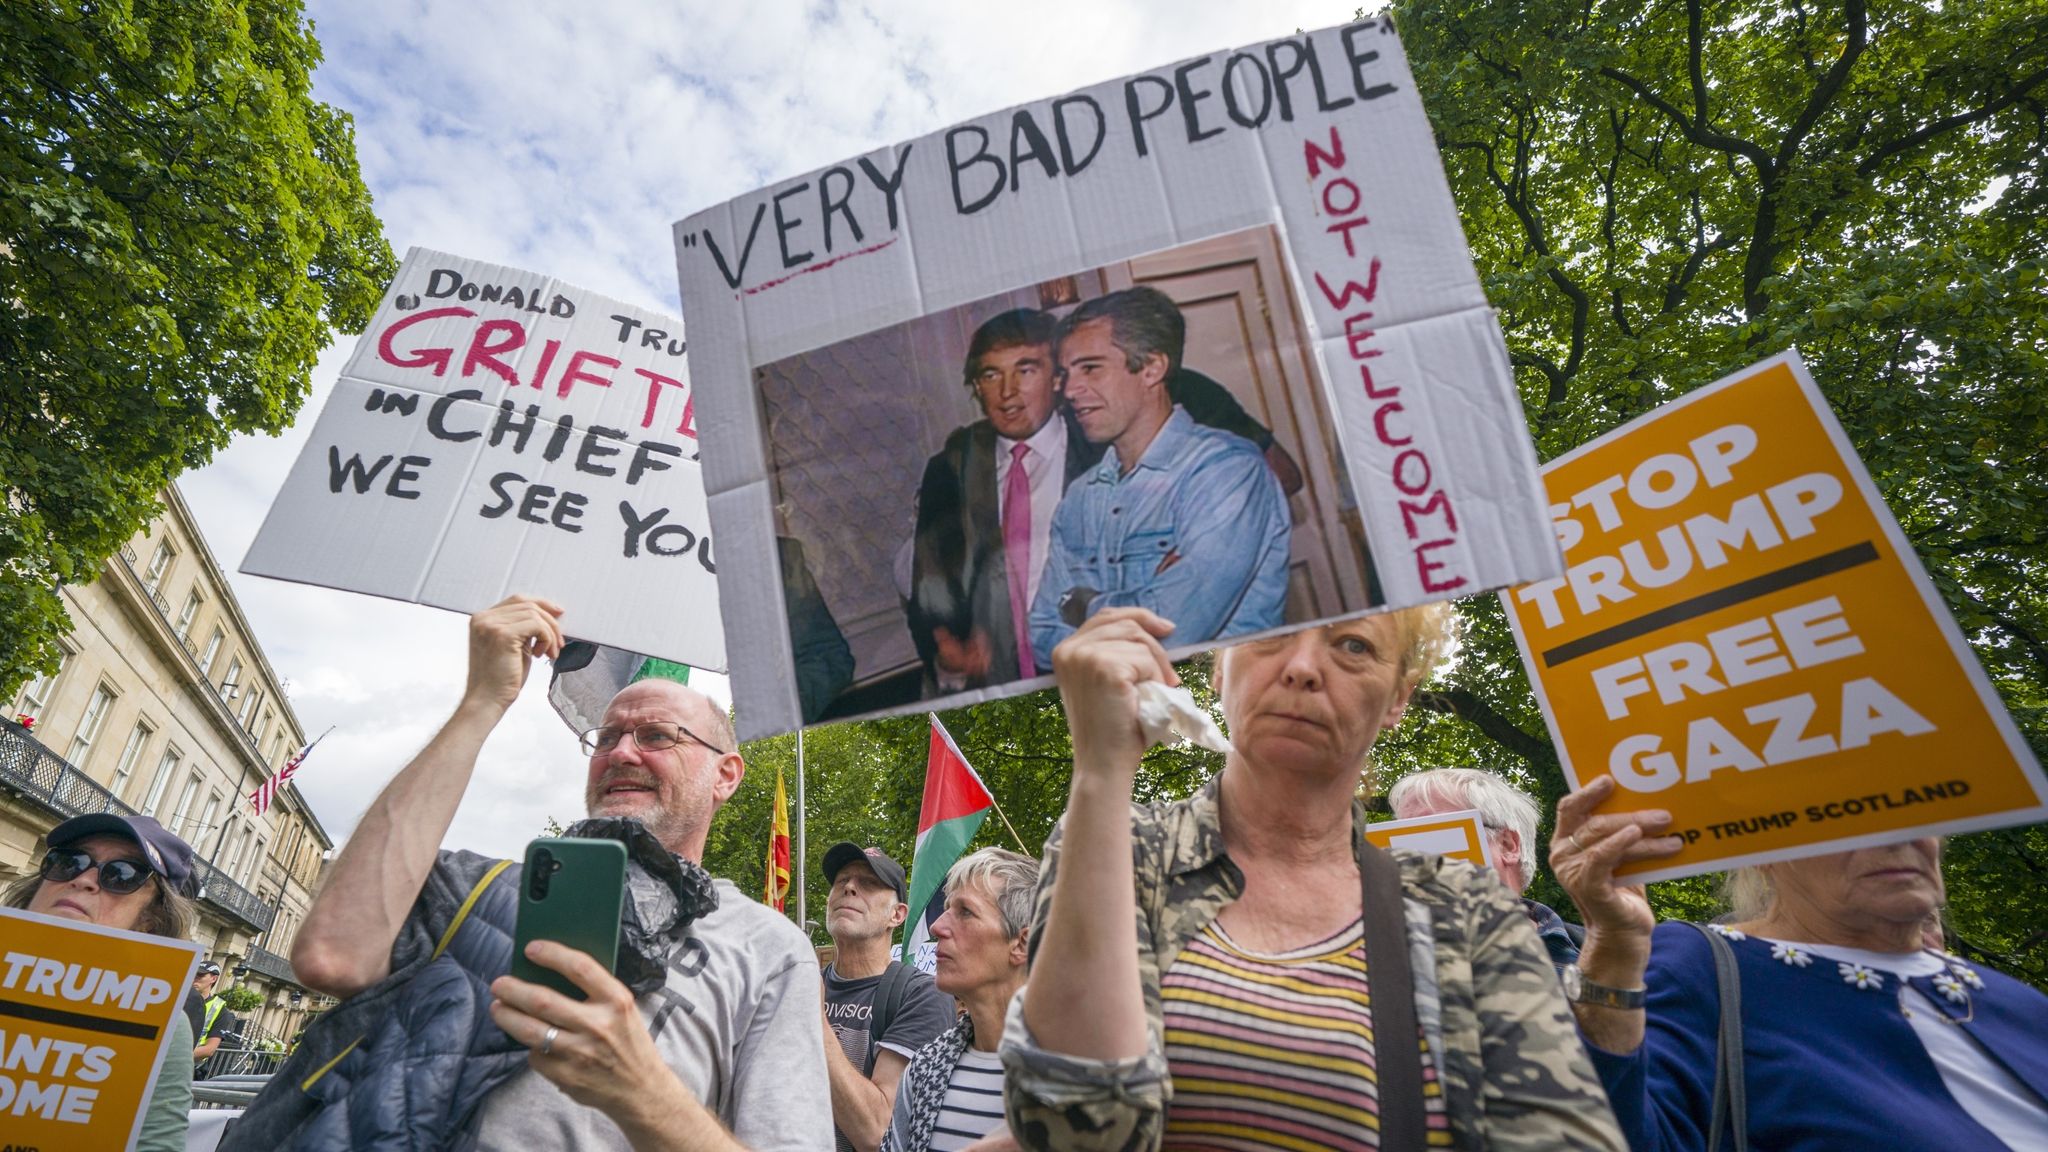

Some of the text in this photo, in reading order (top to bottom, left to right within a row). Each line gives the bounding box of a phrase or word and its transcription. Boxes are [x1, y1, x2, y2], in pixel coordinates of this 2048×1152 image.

[945, 95, 1106, 215] BAD
[425, 269, 687, 356] DONALD TRU
[1304, 126, 1467, 594] NOT WELCOME
[328, 445, 431, 500] WE
[479, 472, 588, 534] SEE
[364, 389, 699, 485] IN CHIEF
[1549, 424, 1758, 552] STOP
[1519, 472, 1844, 630] TRUMP
[1590, 595, 1866, 721] FREE
[1608, 677, 1938, 794] GAZA
[1707, 810, 1799, 841] TRUMP
[1804, 780, 1971, 823] SCOTLAND
[2, 951, 172, 1012] TRUMP
